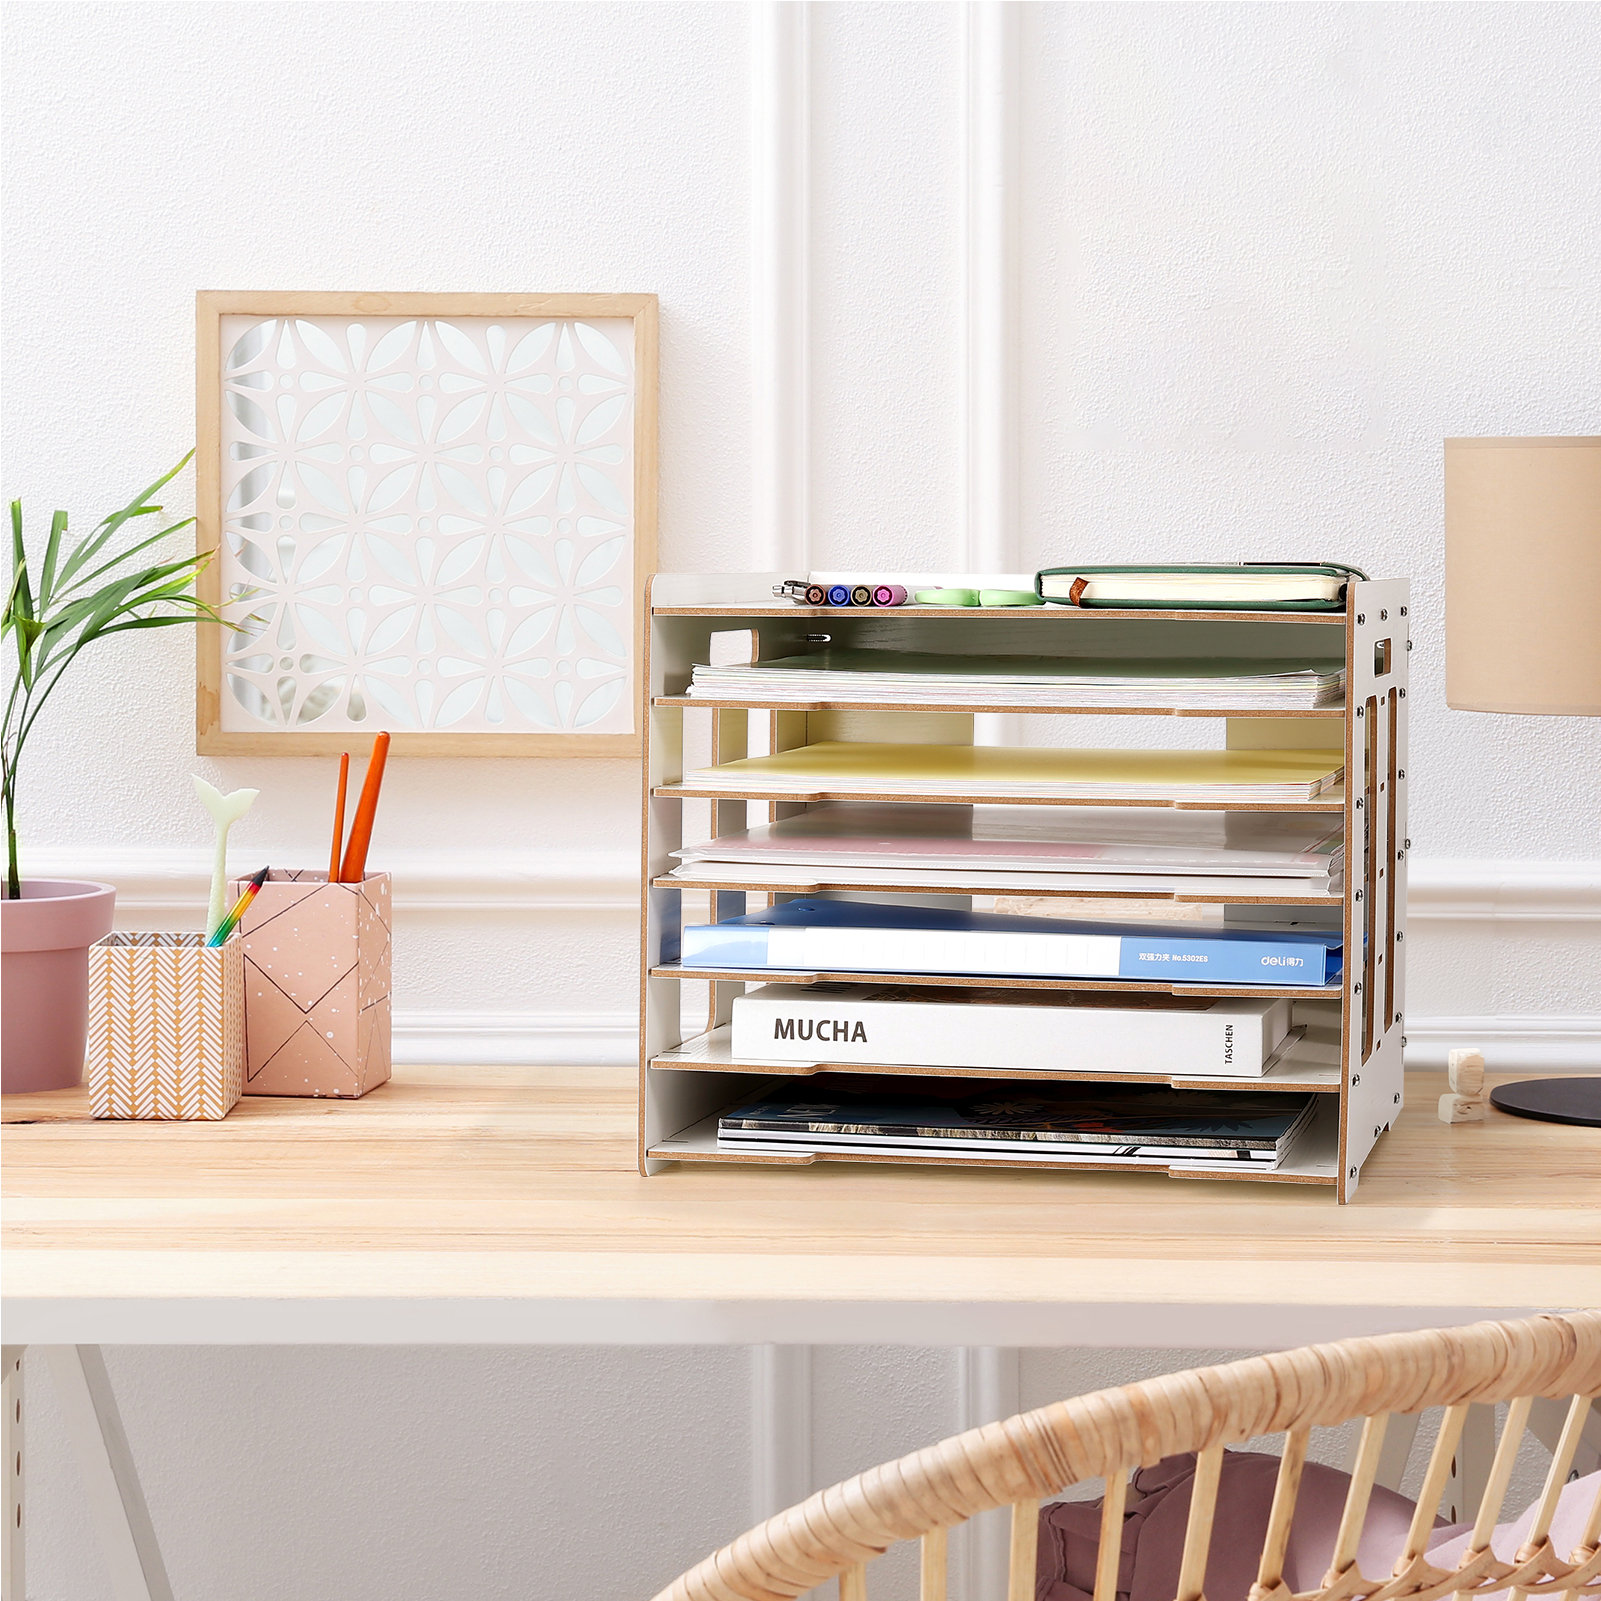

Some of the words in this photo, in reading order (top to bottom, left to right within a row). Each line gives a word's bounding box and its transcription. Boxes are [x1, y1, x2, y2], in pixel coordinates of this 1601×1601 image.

[1171, 954, 1209, 963] No.5302ES
[774, 1018, 868, 1043] MUCHA
[1224, 1024, 1233, 1064] TASCHEN
